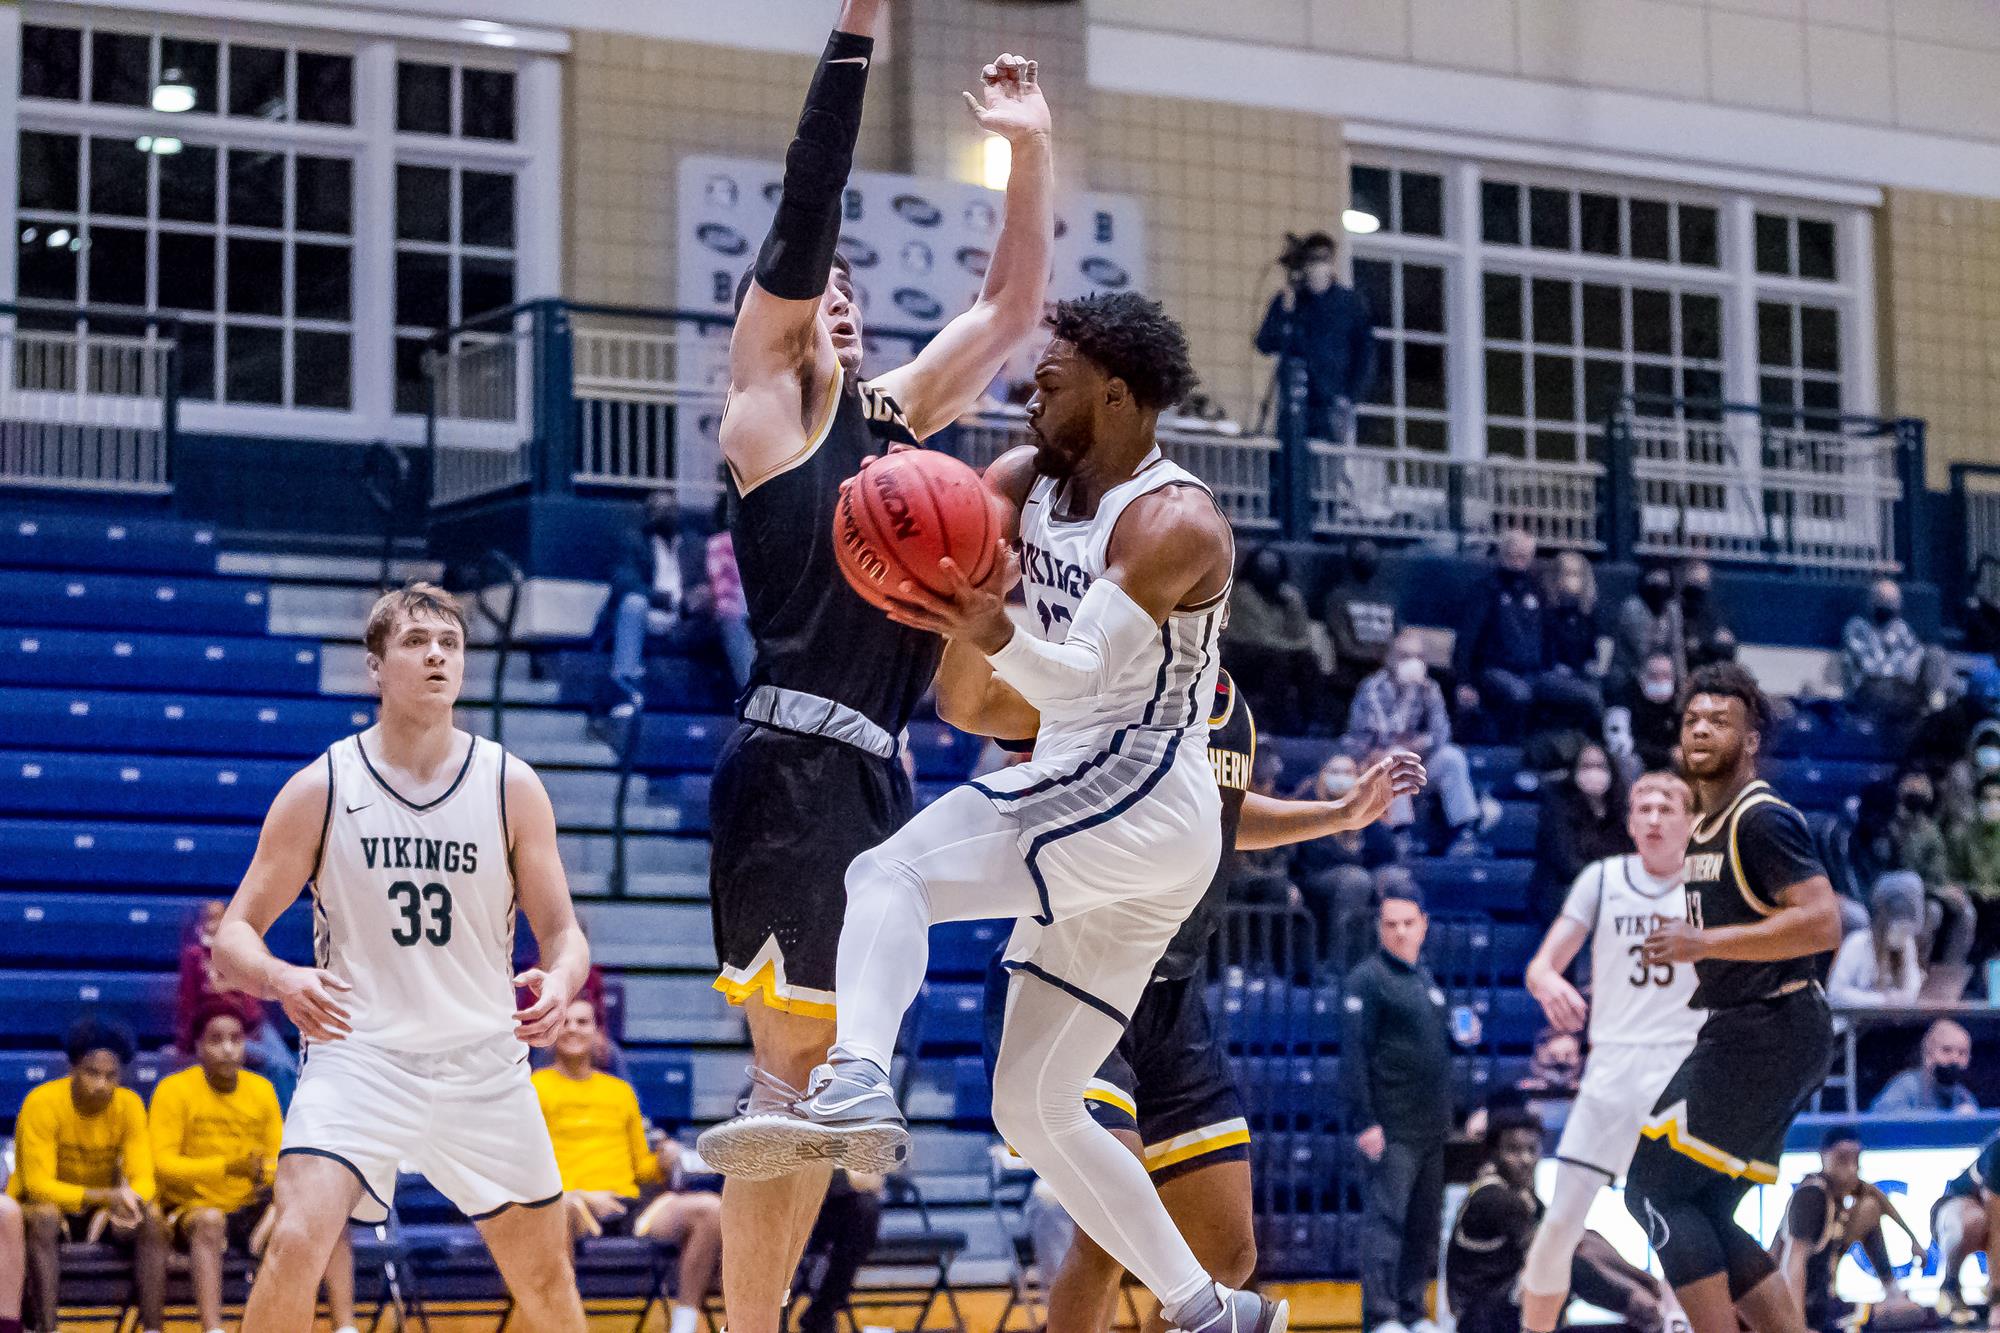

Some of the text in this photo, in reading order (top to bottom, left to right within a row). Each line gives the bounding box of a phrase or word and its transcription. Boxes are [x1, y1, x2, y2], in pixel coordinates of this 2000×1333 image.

[1208, 747, 1250, 790] HERN
[360, 836, 478, 874] VIKINGS
[387, 880, 453, 947] 33
